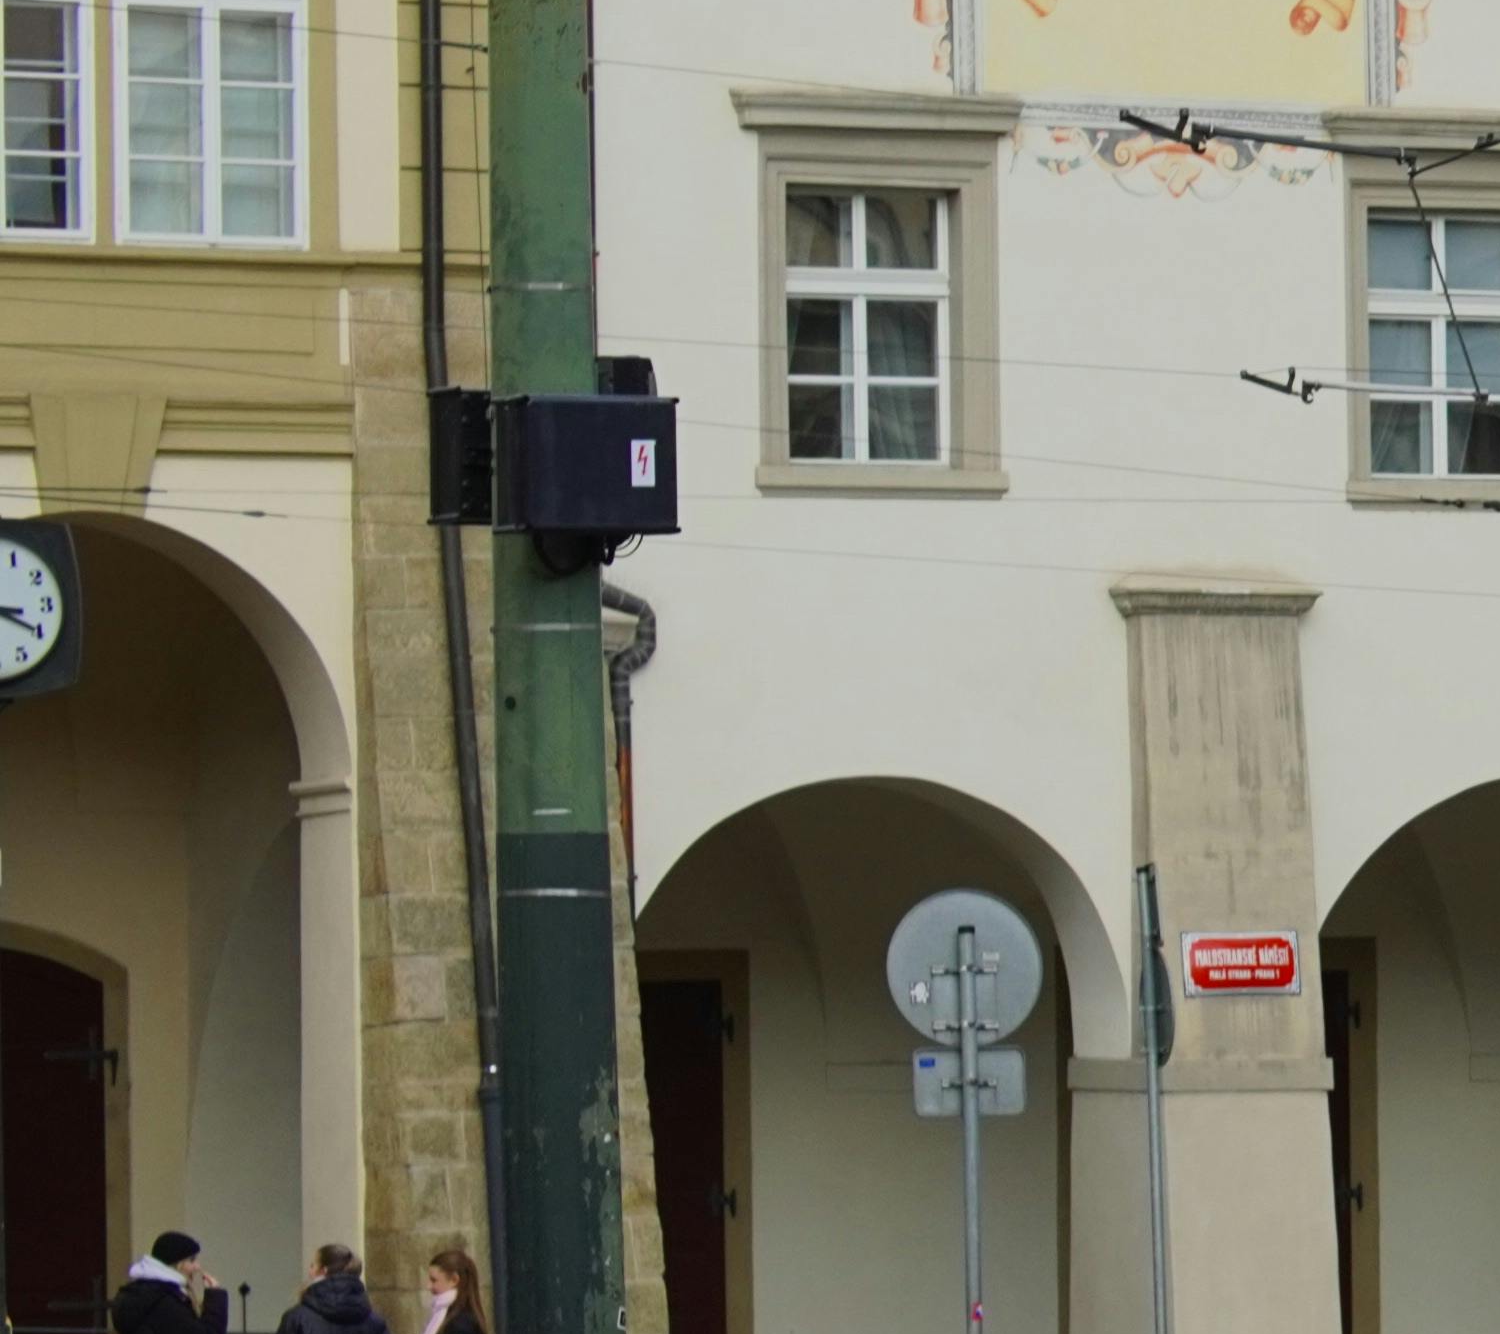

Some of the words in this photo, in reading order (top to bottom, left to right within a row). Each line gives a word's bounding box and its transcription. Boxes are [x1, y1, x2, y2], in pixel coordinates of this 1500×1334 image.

[9, 549, 17, 568] 1
[28, 569, 43, 586] 2
[40, 596, 53, 613] 3
[15, 646, 29, 663] 5
